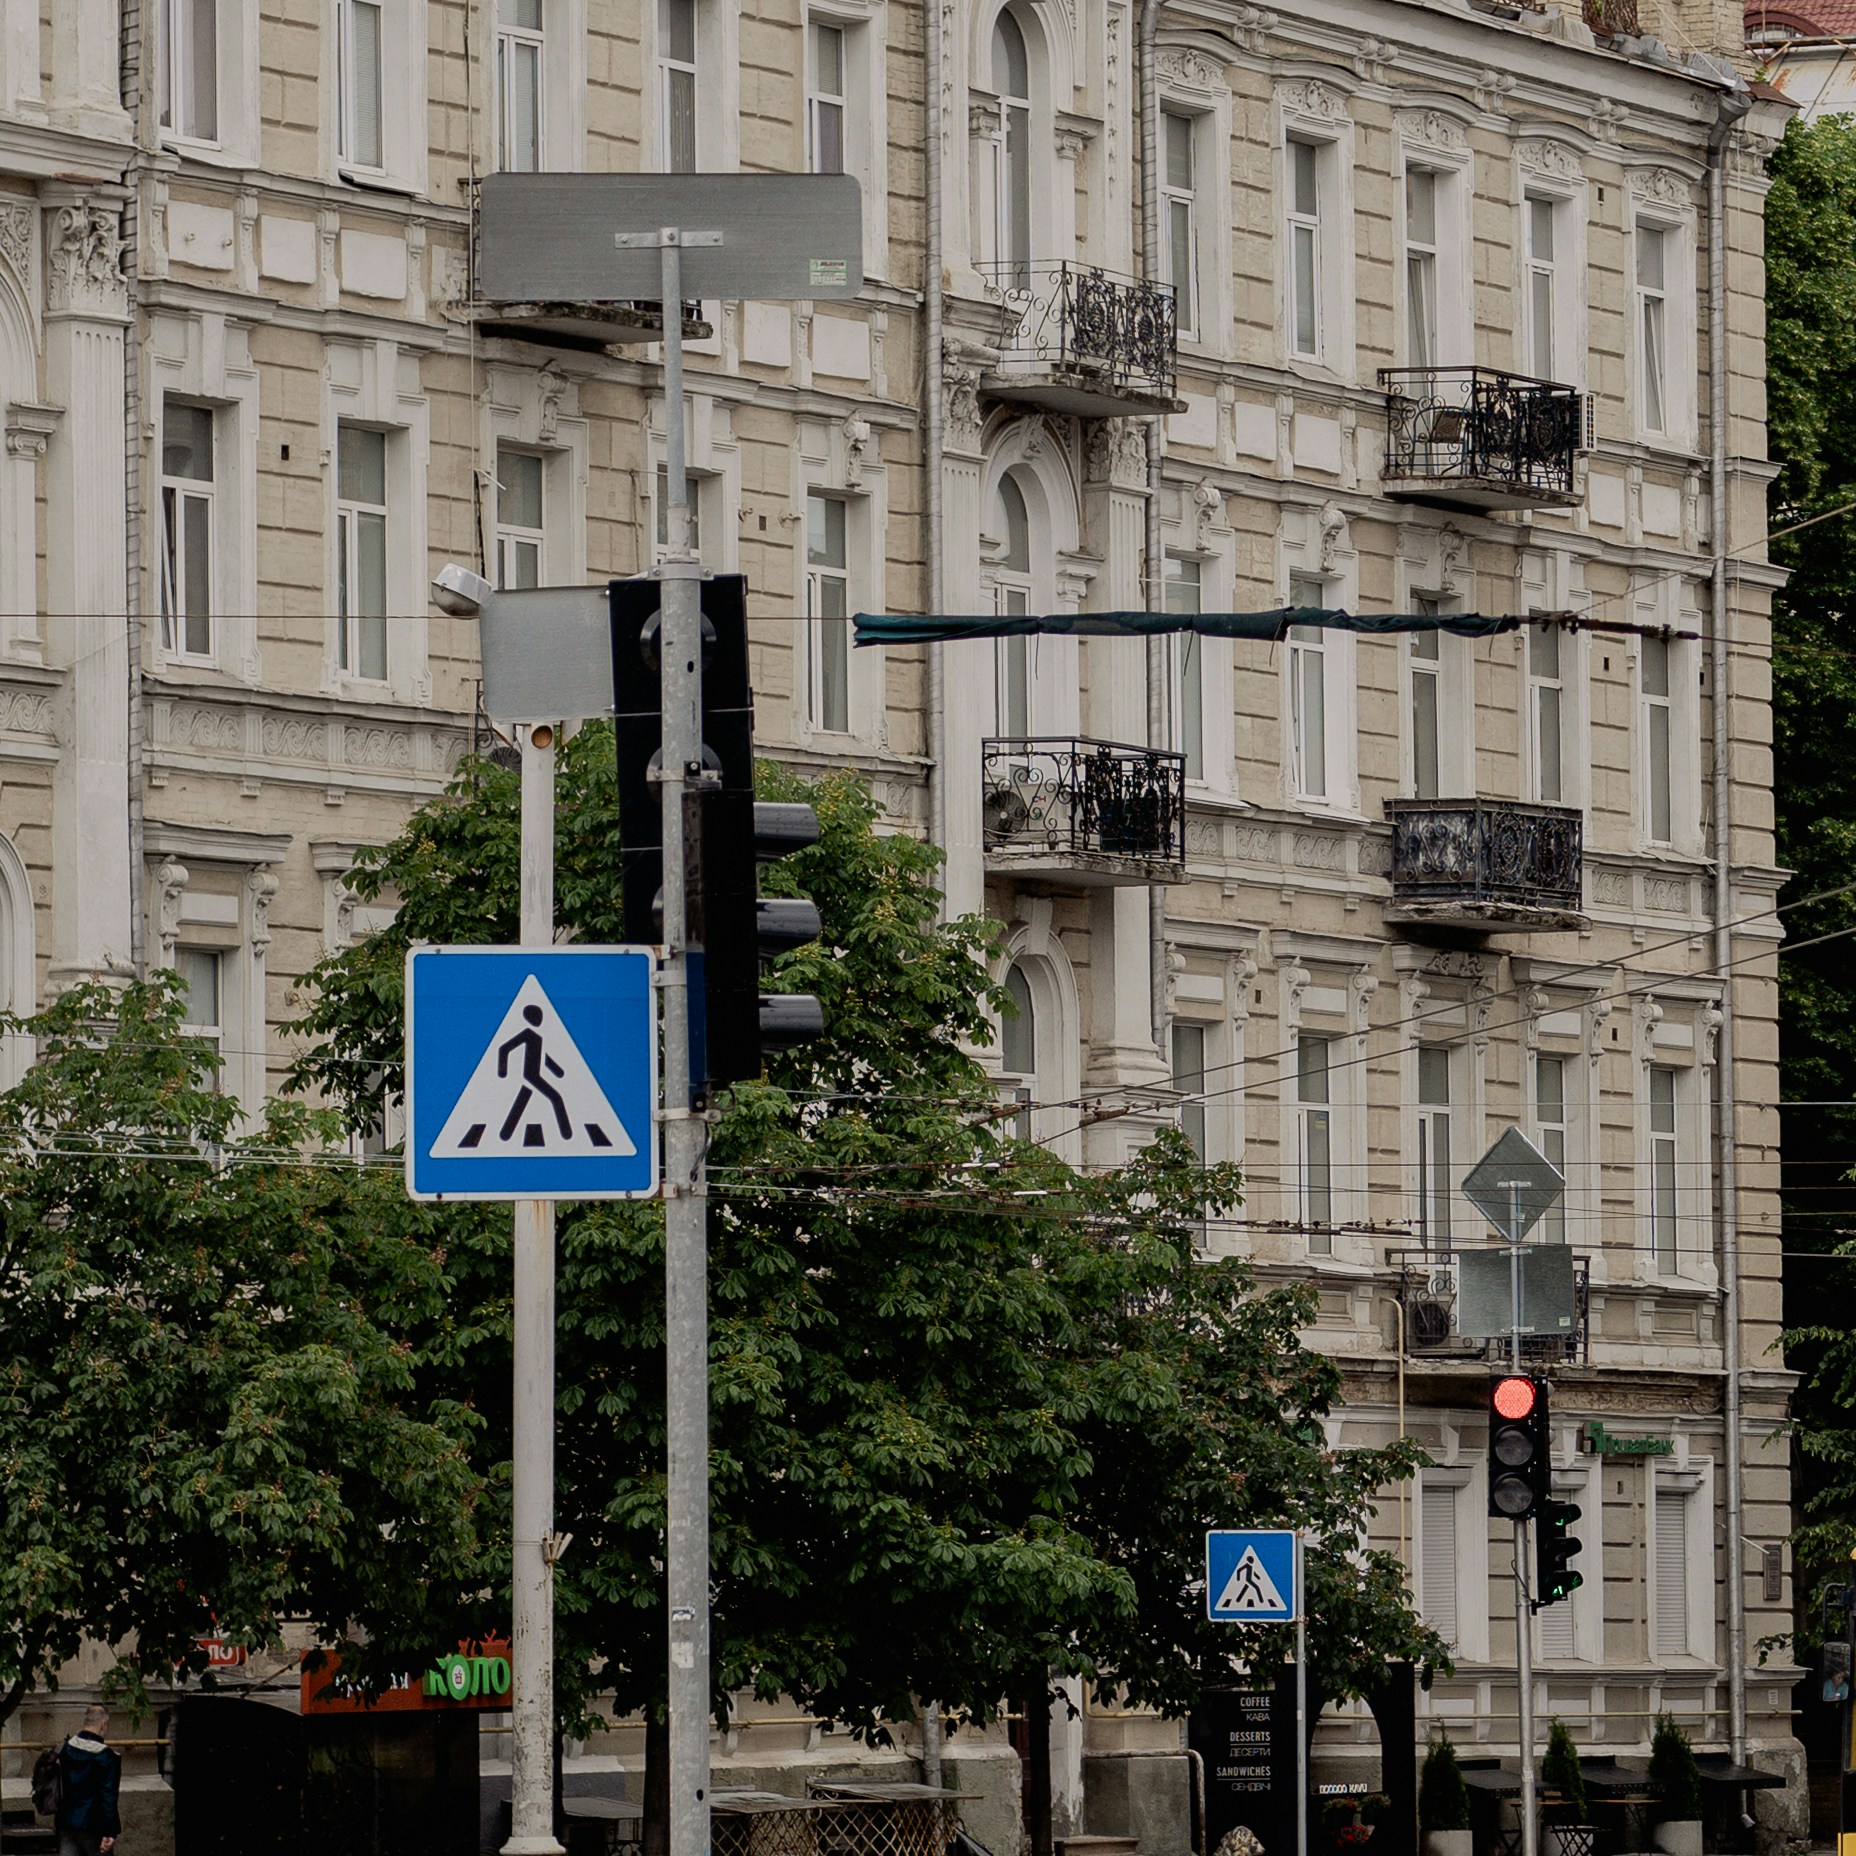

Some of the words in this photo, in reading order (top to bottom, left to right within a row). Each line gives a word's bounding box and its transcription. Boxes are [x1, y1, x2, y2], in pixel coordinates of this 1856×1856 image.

[1240, 1696, 1271, 1707] COFFEE
[1246, 1712, 1271, 1722] КАВА
[1229, 1731, 1271, 1742] DESSERTS
[1229, 1747, 1271, 1758] ДЕСЕРТИ
[1216, 1766, 1272, 1777] SANDWICHES
